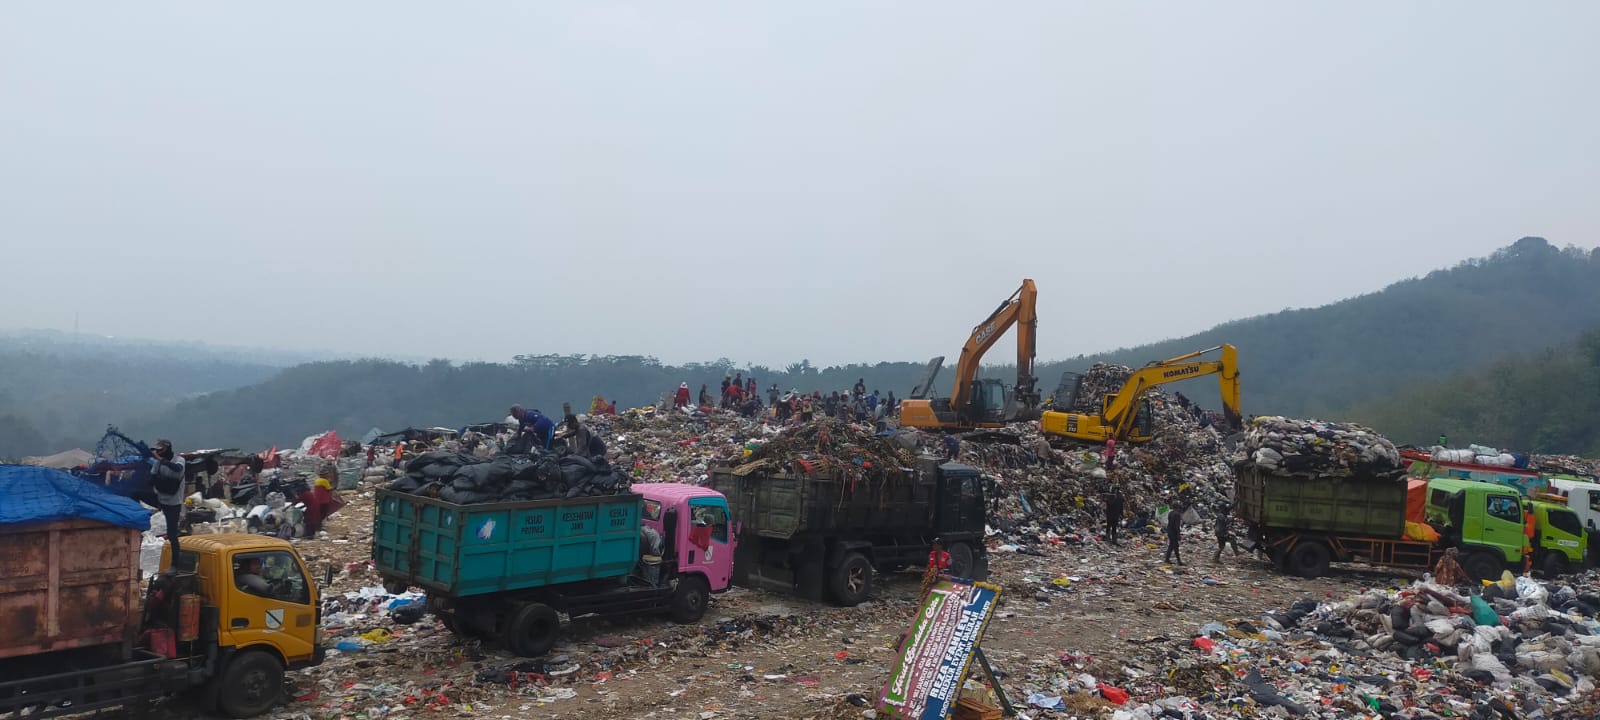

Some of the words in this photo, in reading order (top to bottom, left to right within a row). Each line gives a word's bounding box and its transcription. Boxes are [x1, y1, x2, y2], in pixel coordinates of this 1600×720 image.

[976, 320, 996, 344] CASE
[1163, 366, 1200, 378] KOMATSU
[562, 511, 594, 522] KESEHATAN
[892, 664, 909, 695] Turut
[905, 620, 928, 662] Berduka
[925, 597, 940, 618] Cita
[951, 641, 966, 666] EVENT
[963, 611, 978, 641] DAERAH
[964, 642, 972, 652] DAN
[930, 665, 949, 697] REZA
[945, 610, 971, 661] FAHLEVI
